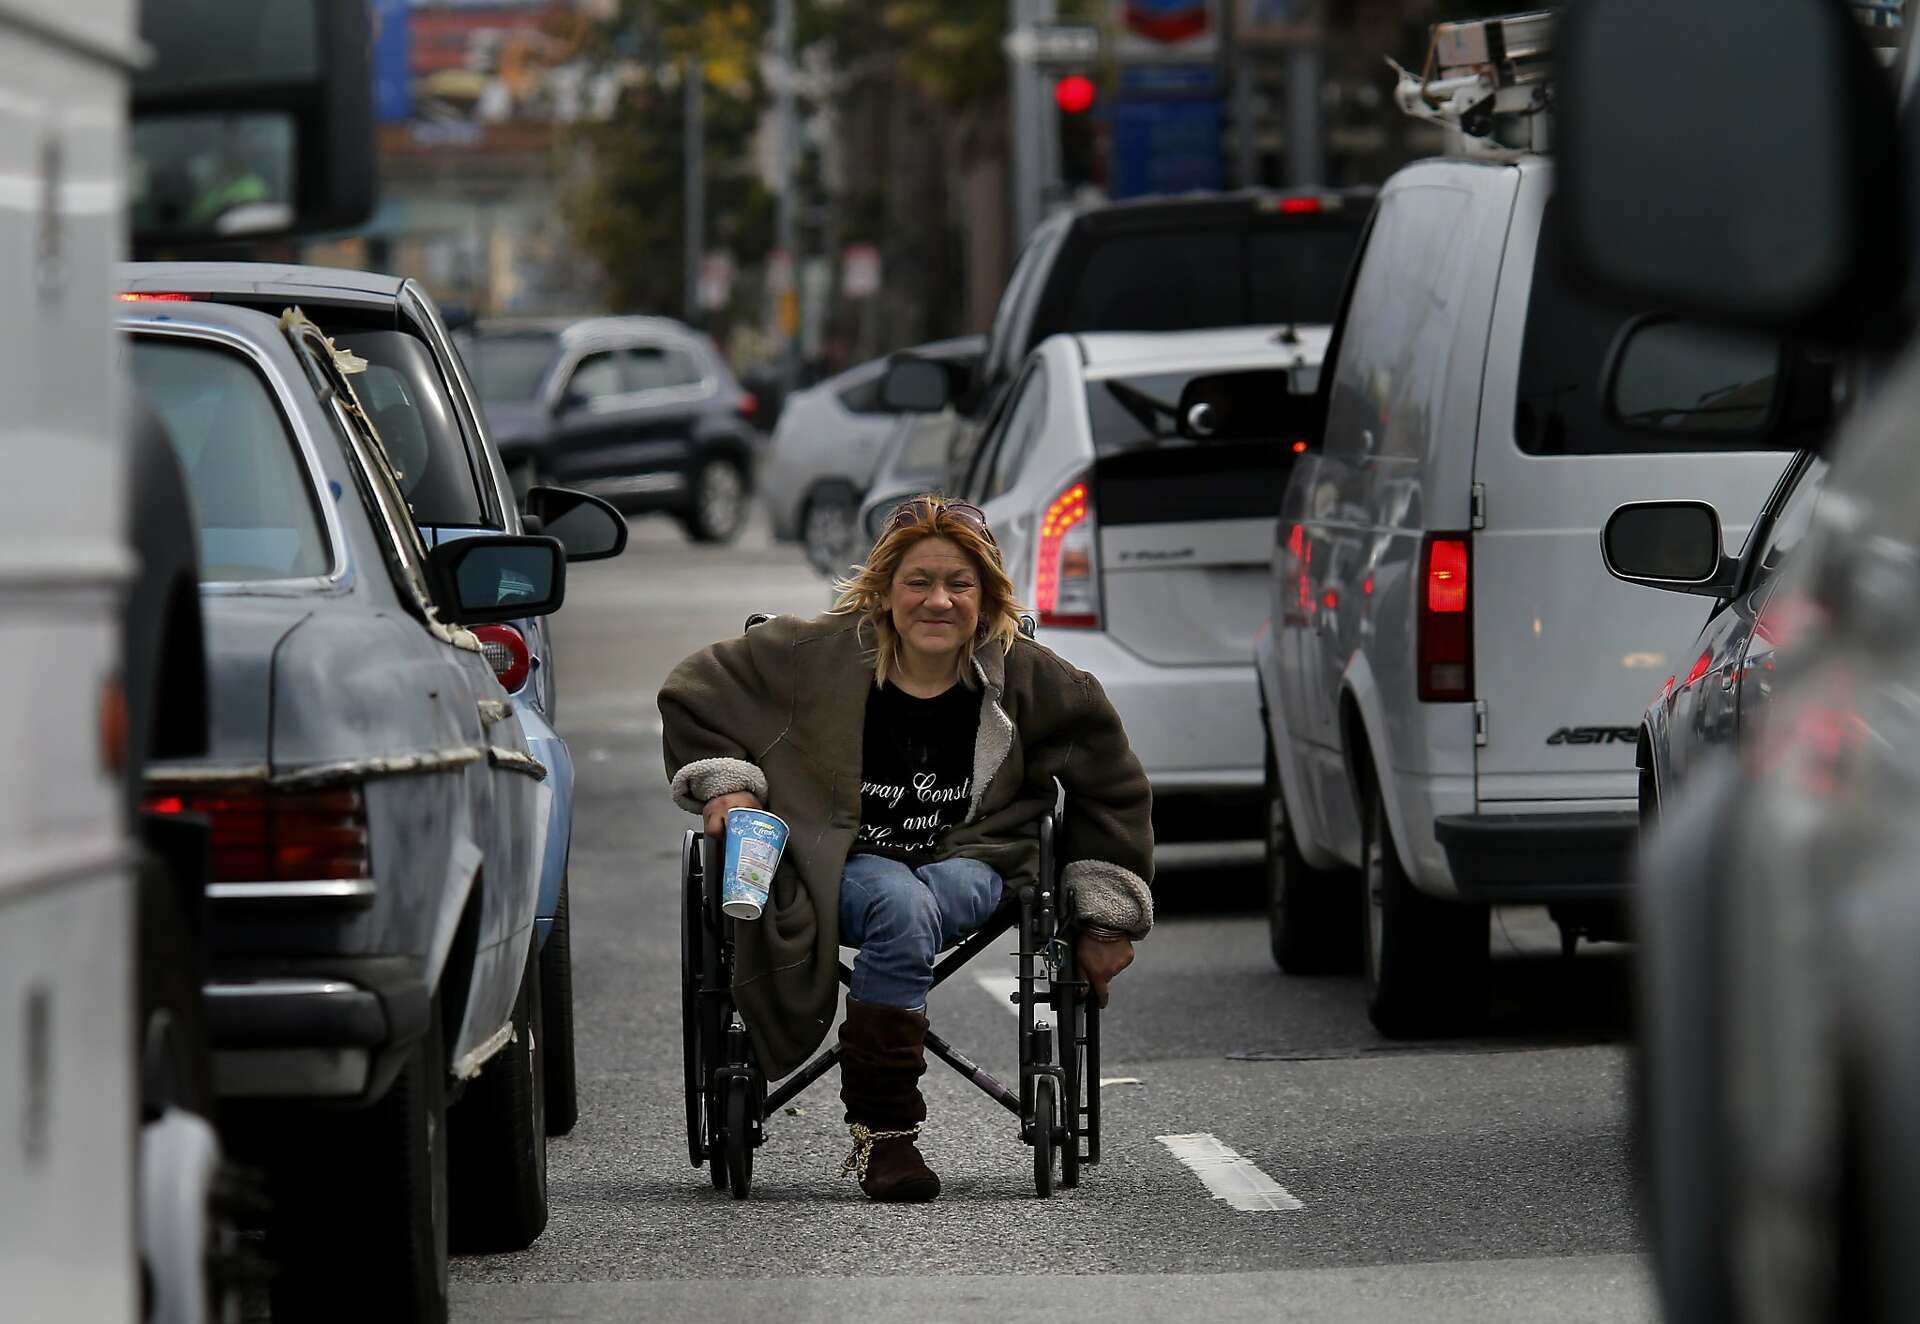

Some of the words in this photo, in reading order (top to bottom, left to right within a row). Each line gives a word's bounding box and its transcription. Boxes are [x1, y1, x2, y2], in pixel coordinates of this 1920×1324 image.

[1546, 726, 1640, 745] ASTR
[913, 772, 971, 802] Const
[903, 809, 941, 830] and
